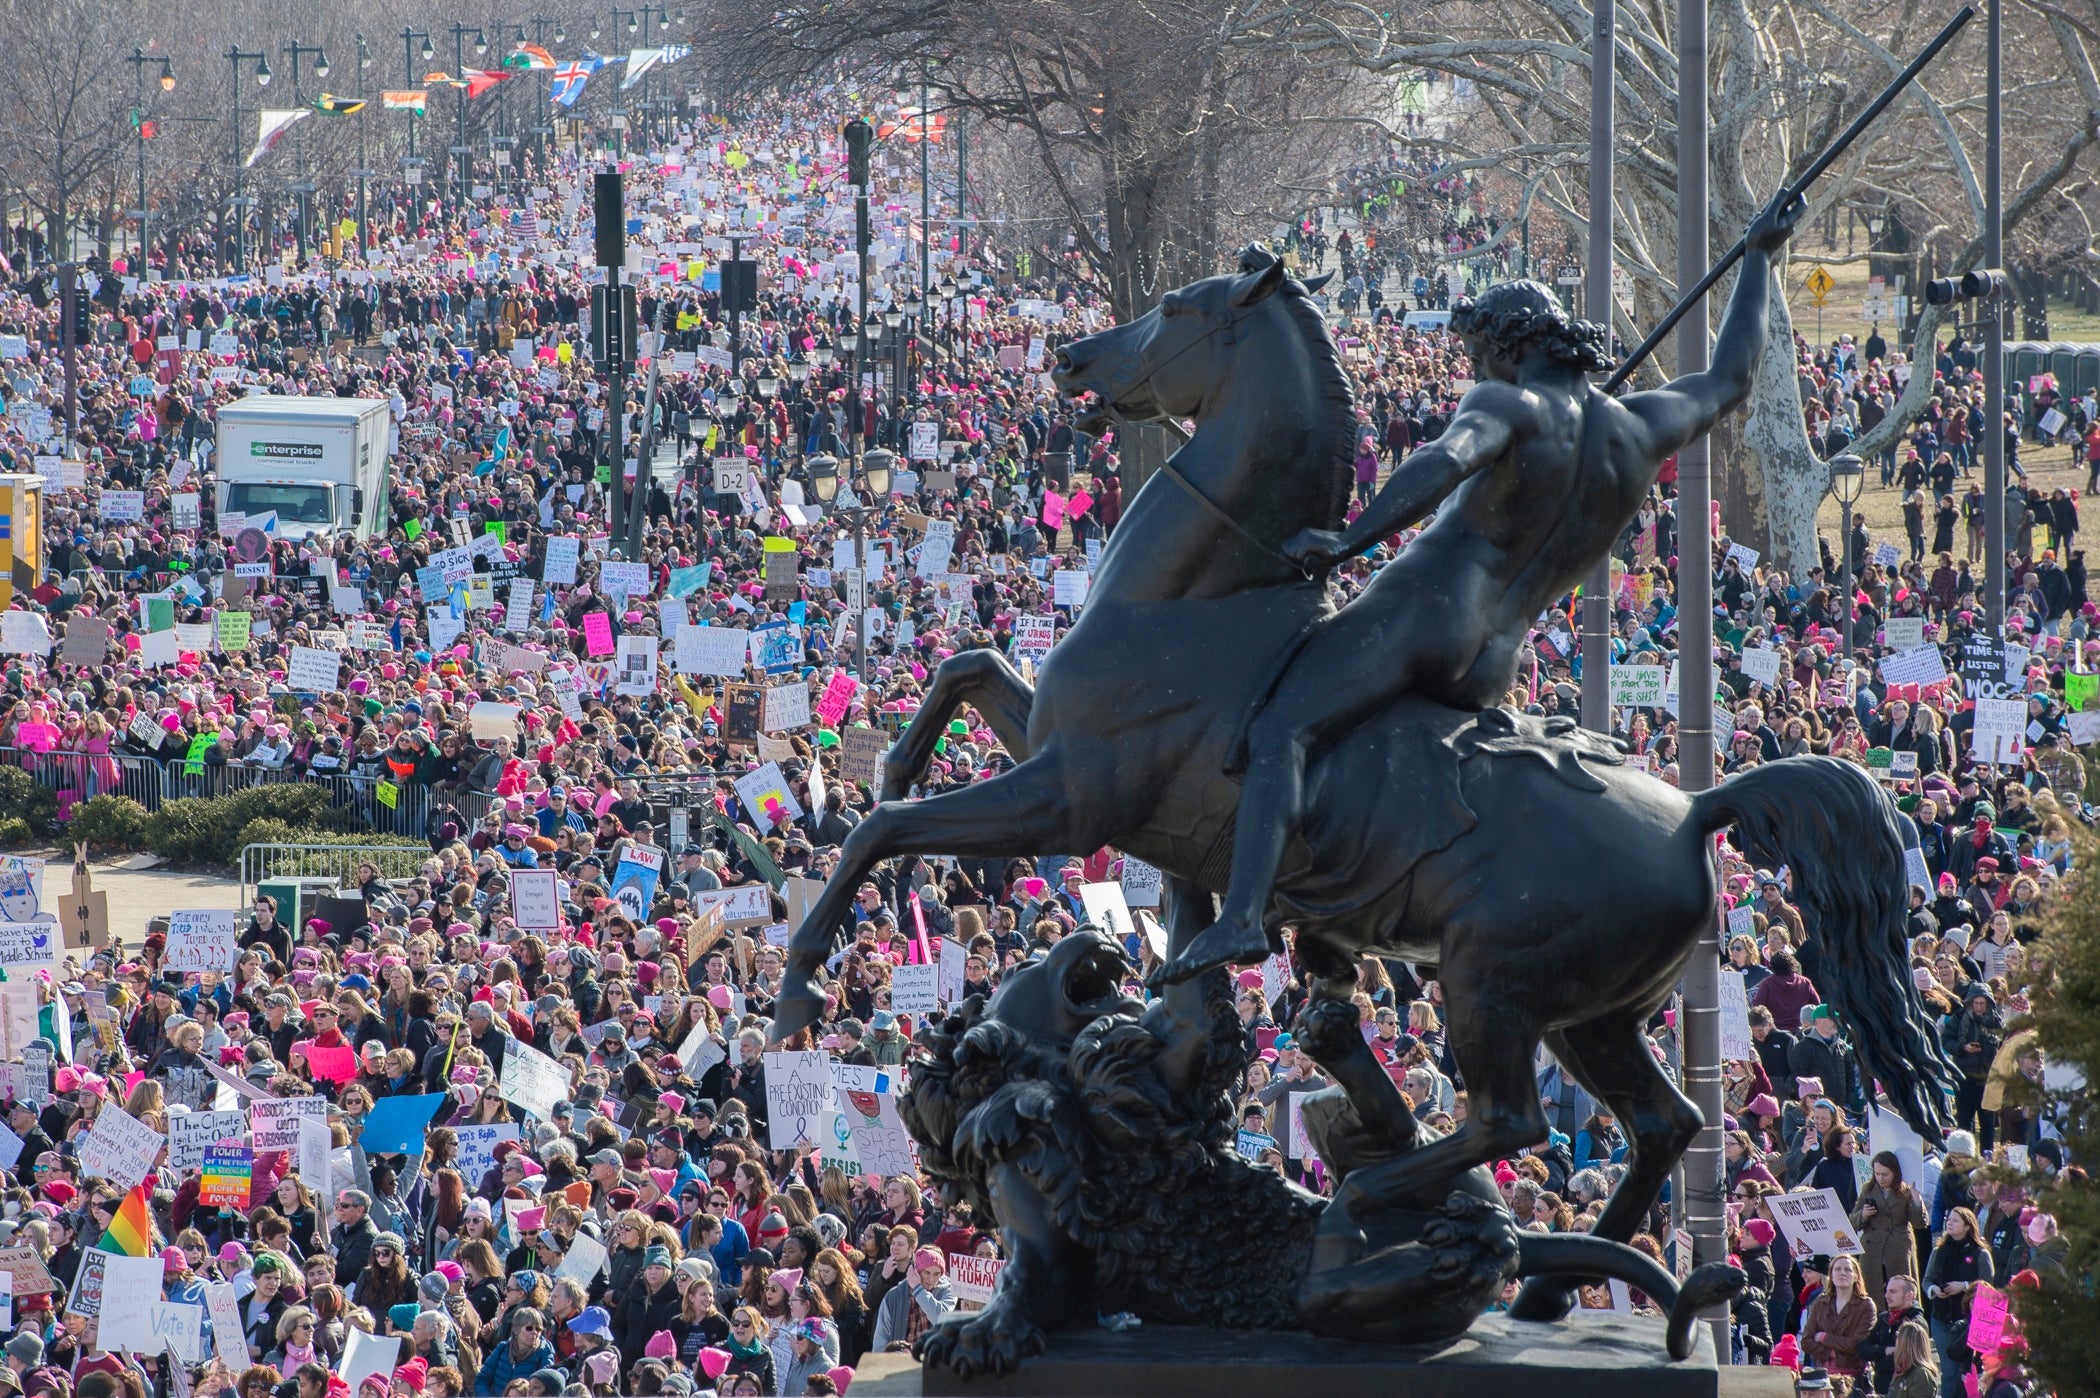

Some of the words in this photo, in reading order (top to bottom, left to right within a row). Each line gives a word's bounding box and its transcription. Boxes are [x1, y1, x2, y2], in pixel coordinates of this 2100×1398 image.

[252, 445, 322, 458] enterprise
[722, 473, 742, 489] D-2
[930, 523, 950, 533] NEVER
[449, 556, 471, 568] SICK
[236, 566, 267, 575] RESIST
[953, 583, 970, 600] 45
[1020, 618, 1029, 627] IF
[1028, 629, 1050, 637] UTERUS
[486, 639, 508, 653] WHO
[1019, 648, 1031, 656] WILL
[1034, 648, 1046, 656] YOU
[1964, 645, 1992, 656] TIME
[487, 650, 502, 658] RUN
[488, 655, 501, 665] THE
[1896, 652, 1906, 660] THE
[1967, 660, 1999, 670] LISTEN
[1612, 668, 1630, 679] YOU
[1635, 670, 1659, 680] HAVE
[789, 685, 807, 699] DUMP
[1617, 690, 1632, 703] LIKE
[1636, 689, 1659, 703] SHIT
[1965, 679, 2007, 699] WOC
[767, 704, 777, 713] IS
[779, 701, 788, 711] THE
[790, 697, 804, 708] ONLY
[818, 700, 846, 720] SHIT
[2006, 702, 2021, 711] LET
[1976, 711, 1988, 719] THE
[846, 731, 885, 743] Womens
[845, 738, 878, 753] Rights
[844, 753, 875, 766] Human
[843, 763, 874, 777] Rights
[629, 849, 655, 864] LAW
[175, 912, 190, 923] THE
[192, 913, 210, 923] ONLY
[724, 909, 760, 920] VOLUTION
[1729, 909, 1749, 920] DON'T
[0, 930, 21, 938] eave
[23, 926, 51, 937] twitter
[171, 924, 192, 935] TIRED
[1731, 919, 1752, 932] HATE
[1, 939, 16, 947] ars
[20, 938, 31, 947] to
[183, 933, 208, 944] TIRED
[211, 934, 224, 944] OF
[898, 968, 911, 977] The
[913, 967, 931, 976] Most
[893, 993, 910, 1001] person
[772, 1053, 783, 1069] I
[798, 1052, 823, 1068] AM
[789, 1069, 802, 1083] A
[769, 1082, 830, 1102] PRE-EXISTING
[252, 1101, 293, 1118] NOBODY'S
[297, 1101, 325, 1116] FREE
[779, 1100, 823, 1117] CONDITION
[102, 1106, 113, 1117] IF
[118, 1113, 136, 1131] YOU
[171, 1116, 199, 1131] The
[200, 1113, 240, 1130] Climate
[98, 1116, 121, 1138] FIGHT
[124, 1134, 140, 1152] FOR
[140, 1147, 154, 1162] ALL
[195, 1130, 210, 1142] the
[211, 1126, 238, 1142] ONLY
[479, 1128, 497, 1143] Rights
[856, 1130, 896, 1149] SHE
[1239, 1133, 1271, 1147] GRABBING
[179, 1145, 203, 1155] Thin
[213, 1147, 242, 1157] POWER
[465, 1143, 477, 1153] Are
[86, 1138, 113, 1162] FIGHT
[120, 1159, 138, 1177] FOR
[130, 1154, 147, 1171] YOU
[478, 1153, 495, 1168] Right
[860, 1147, 911, 1165] SAID
[85, 1151, 100, 1168] NO
[107, 1164, 138, 1187] WOMEN
[821, 1156, 862, 1176] RESIST
[875, 1162, 901, 1177] NO
[207, 1184, 231, 1192] PEOPLE
[209, 1194, 240, 1204] POWER
[1778, 1199, 1805, 1217] WORST
[1801, 1194, 1830, 1212] PRESIDENT
[19, 1252, 32, 1261] UP
[951, 1255, 982, 1272] MAKE
[32, 1278, 52, 1289] UP
[957, 1270, 995, 1288] HUMAN
[213, 1299, 237, 1313] UGH!
[150, 1307, 184, 1337] Vote
